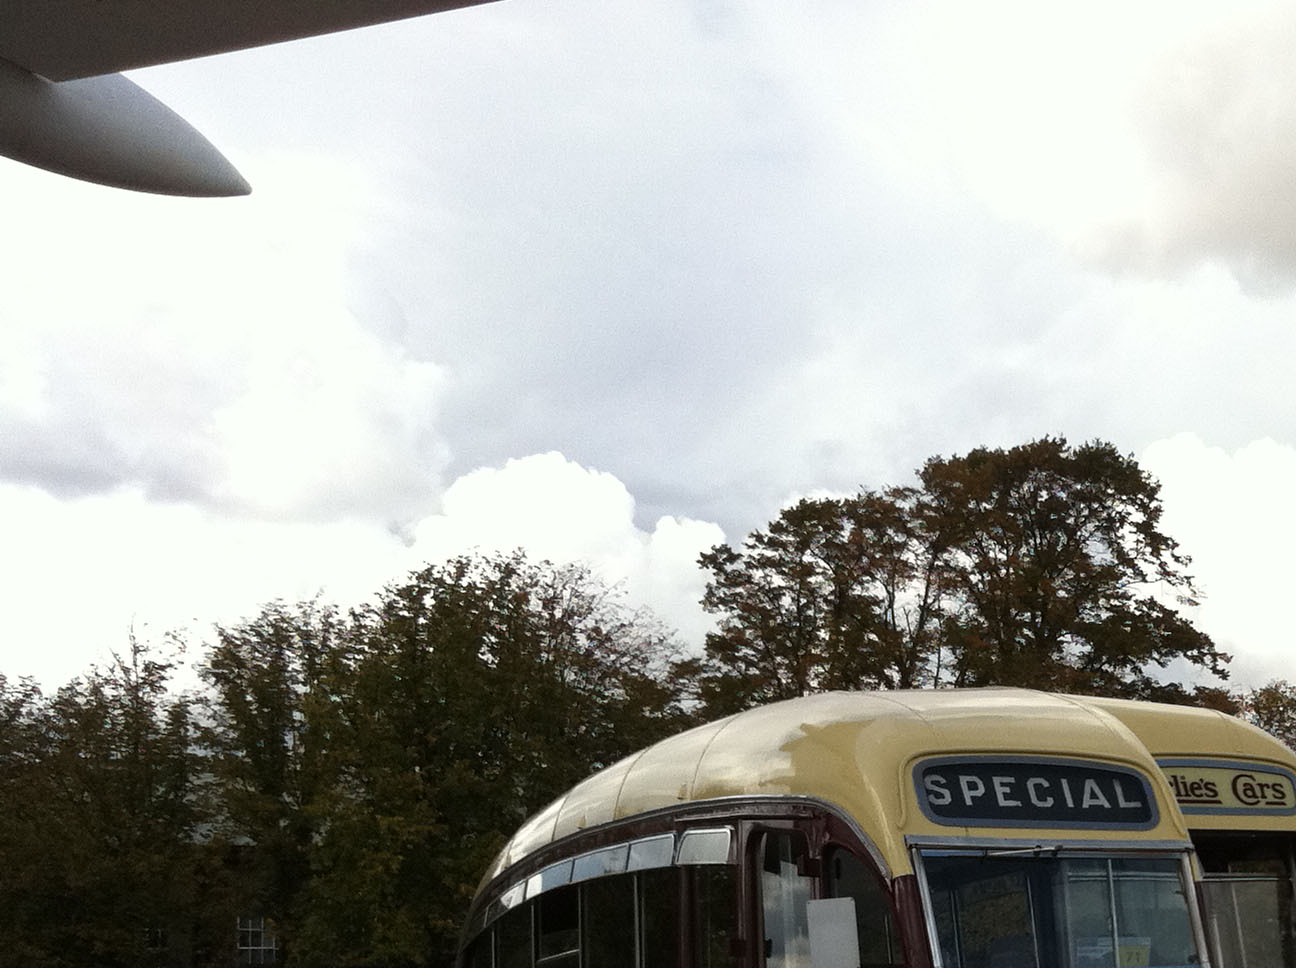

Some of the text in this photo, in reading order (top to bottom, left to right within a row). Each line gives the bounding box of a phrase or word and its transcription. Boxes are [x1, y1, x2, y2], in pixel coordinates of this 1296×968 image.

[923, 774, 1143, 809] SPECIAL
[1169, 773, 1287, 806] lie's Cars
